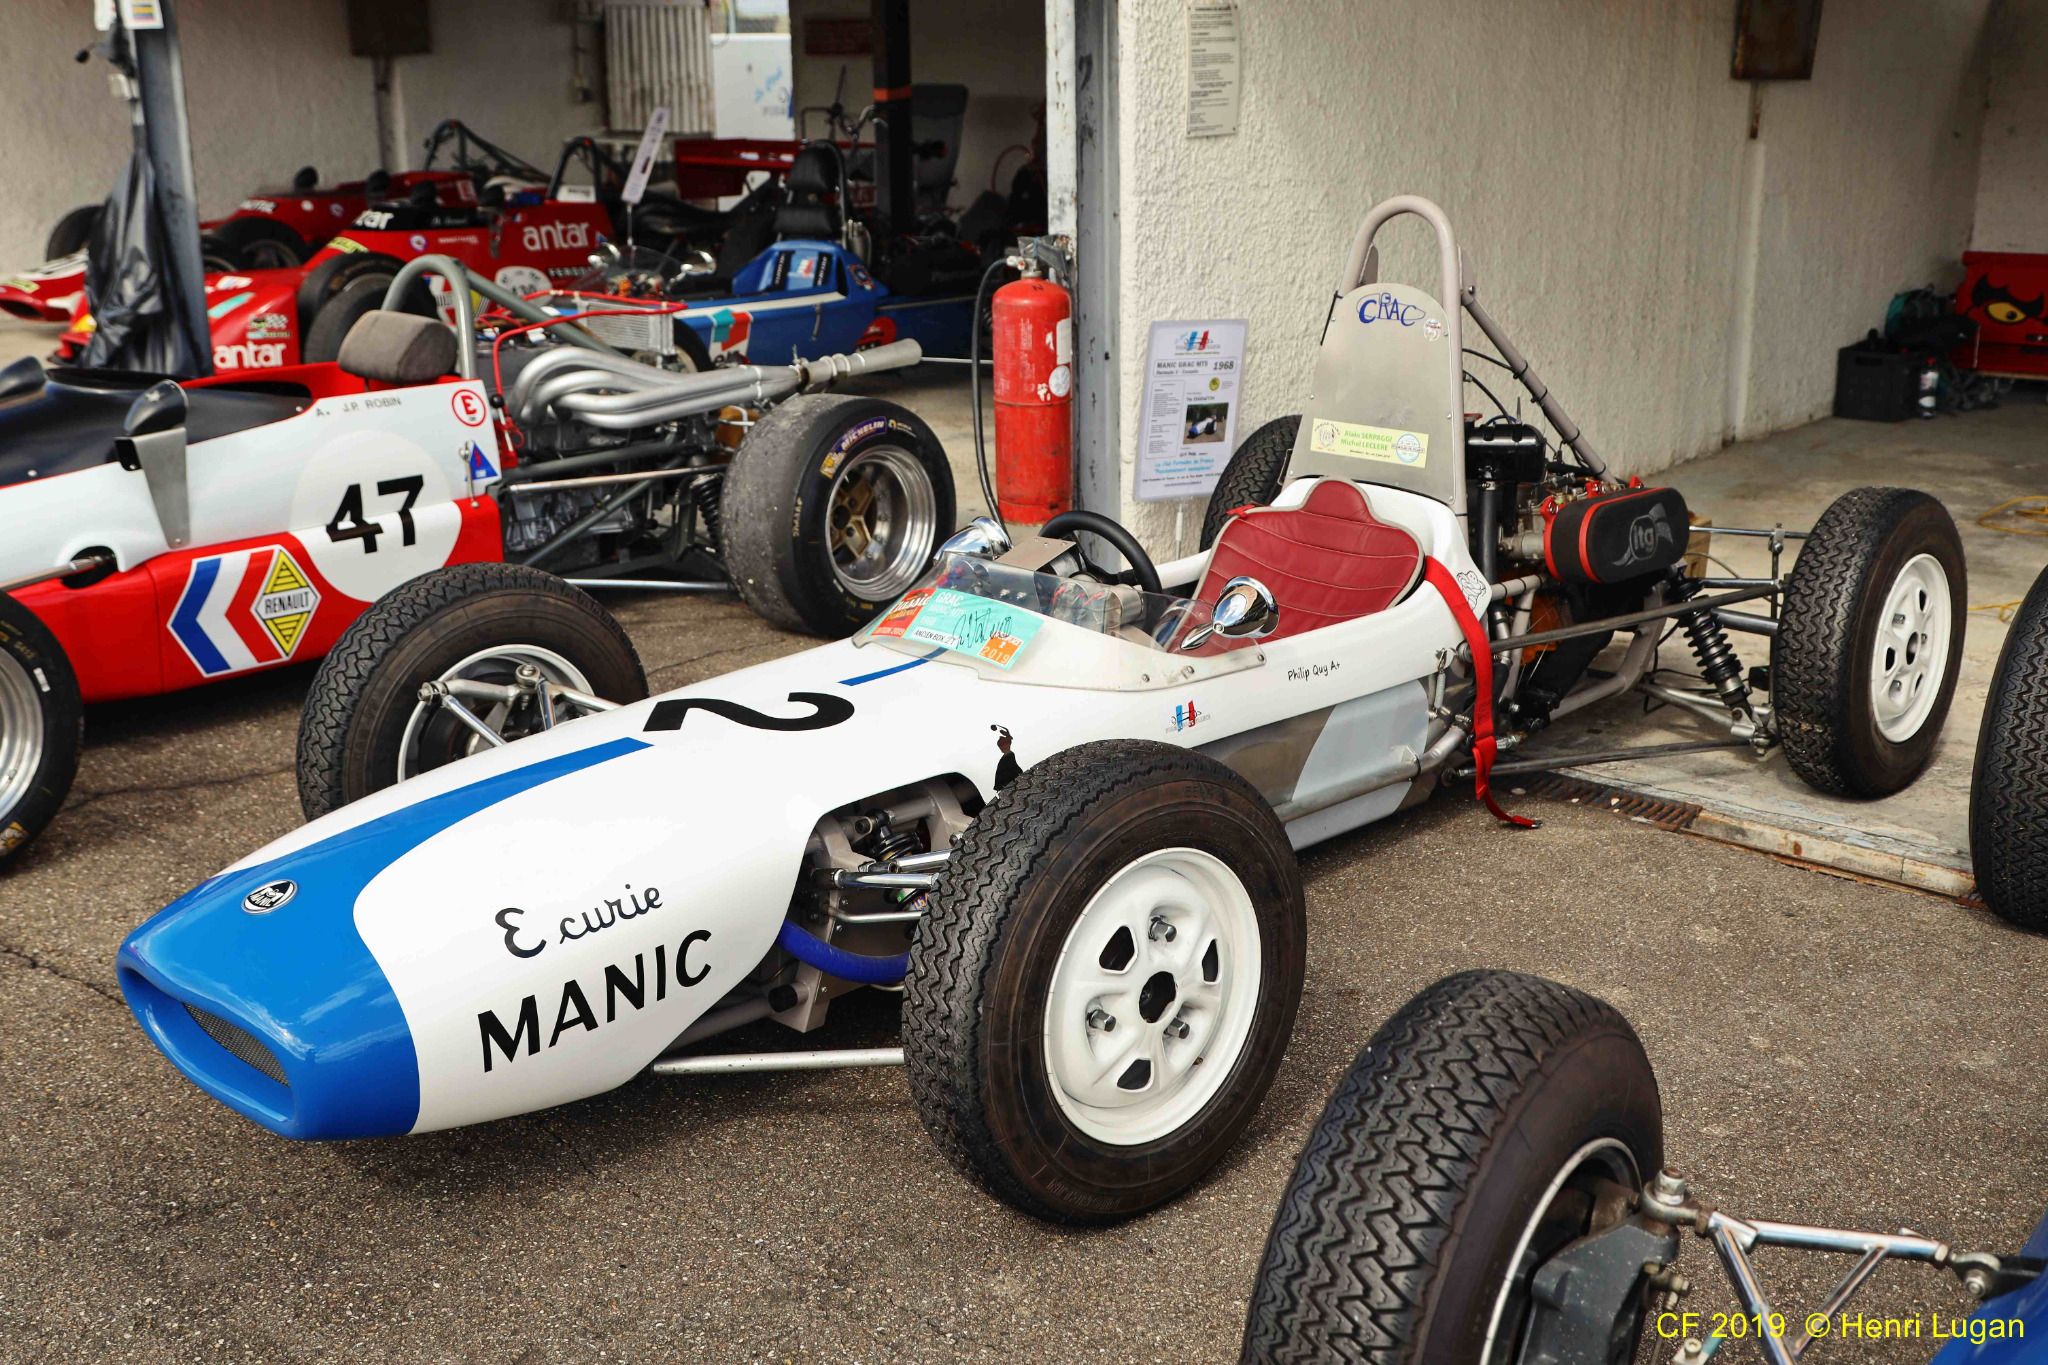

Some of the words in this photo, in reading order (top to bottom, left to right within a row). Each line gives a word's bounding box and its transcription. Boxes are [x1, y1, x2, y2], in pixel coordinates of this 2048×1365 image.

[522, 221, 590, 251] antar
[213, 341, 287, 369] antar
[1213, 361, 1235, 370] 1968
[366, 398, 403, 410] ROBIN
[461, 395, 477, 415] E
[841, 421, 885, 451] MICHELIN
[326, 474, 424, 554] 47
[1633, 525, 1655, 553] itg
[264, 591, 310, 614] RENAULT
[980, 646, 1011, 664] 2019
[1288, 667, 1310, 681] Philip
[643, 692, 855, 732] 2
[478, 929, 712, 1073] MANIC
